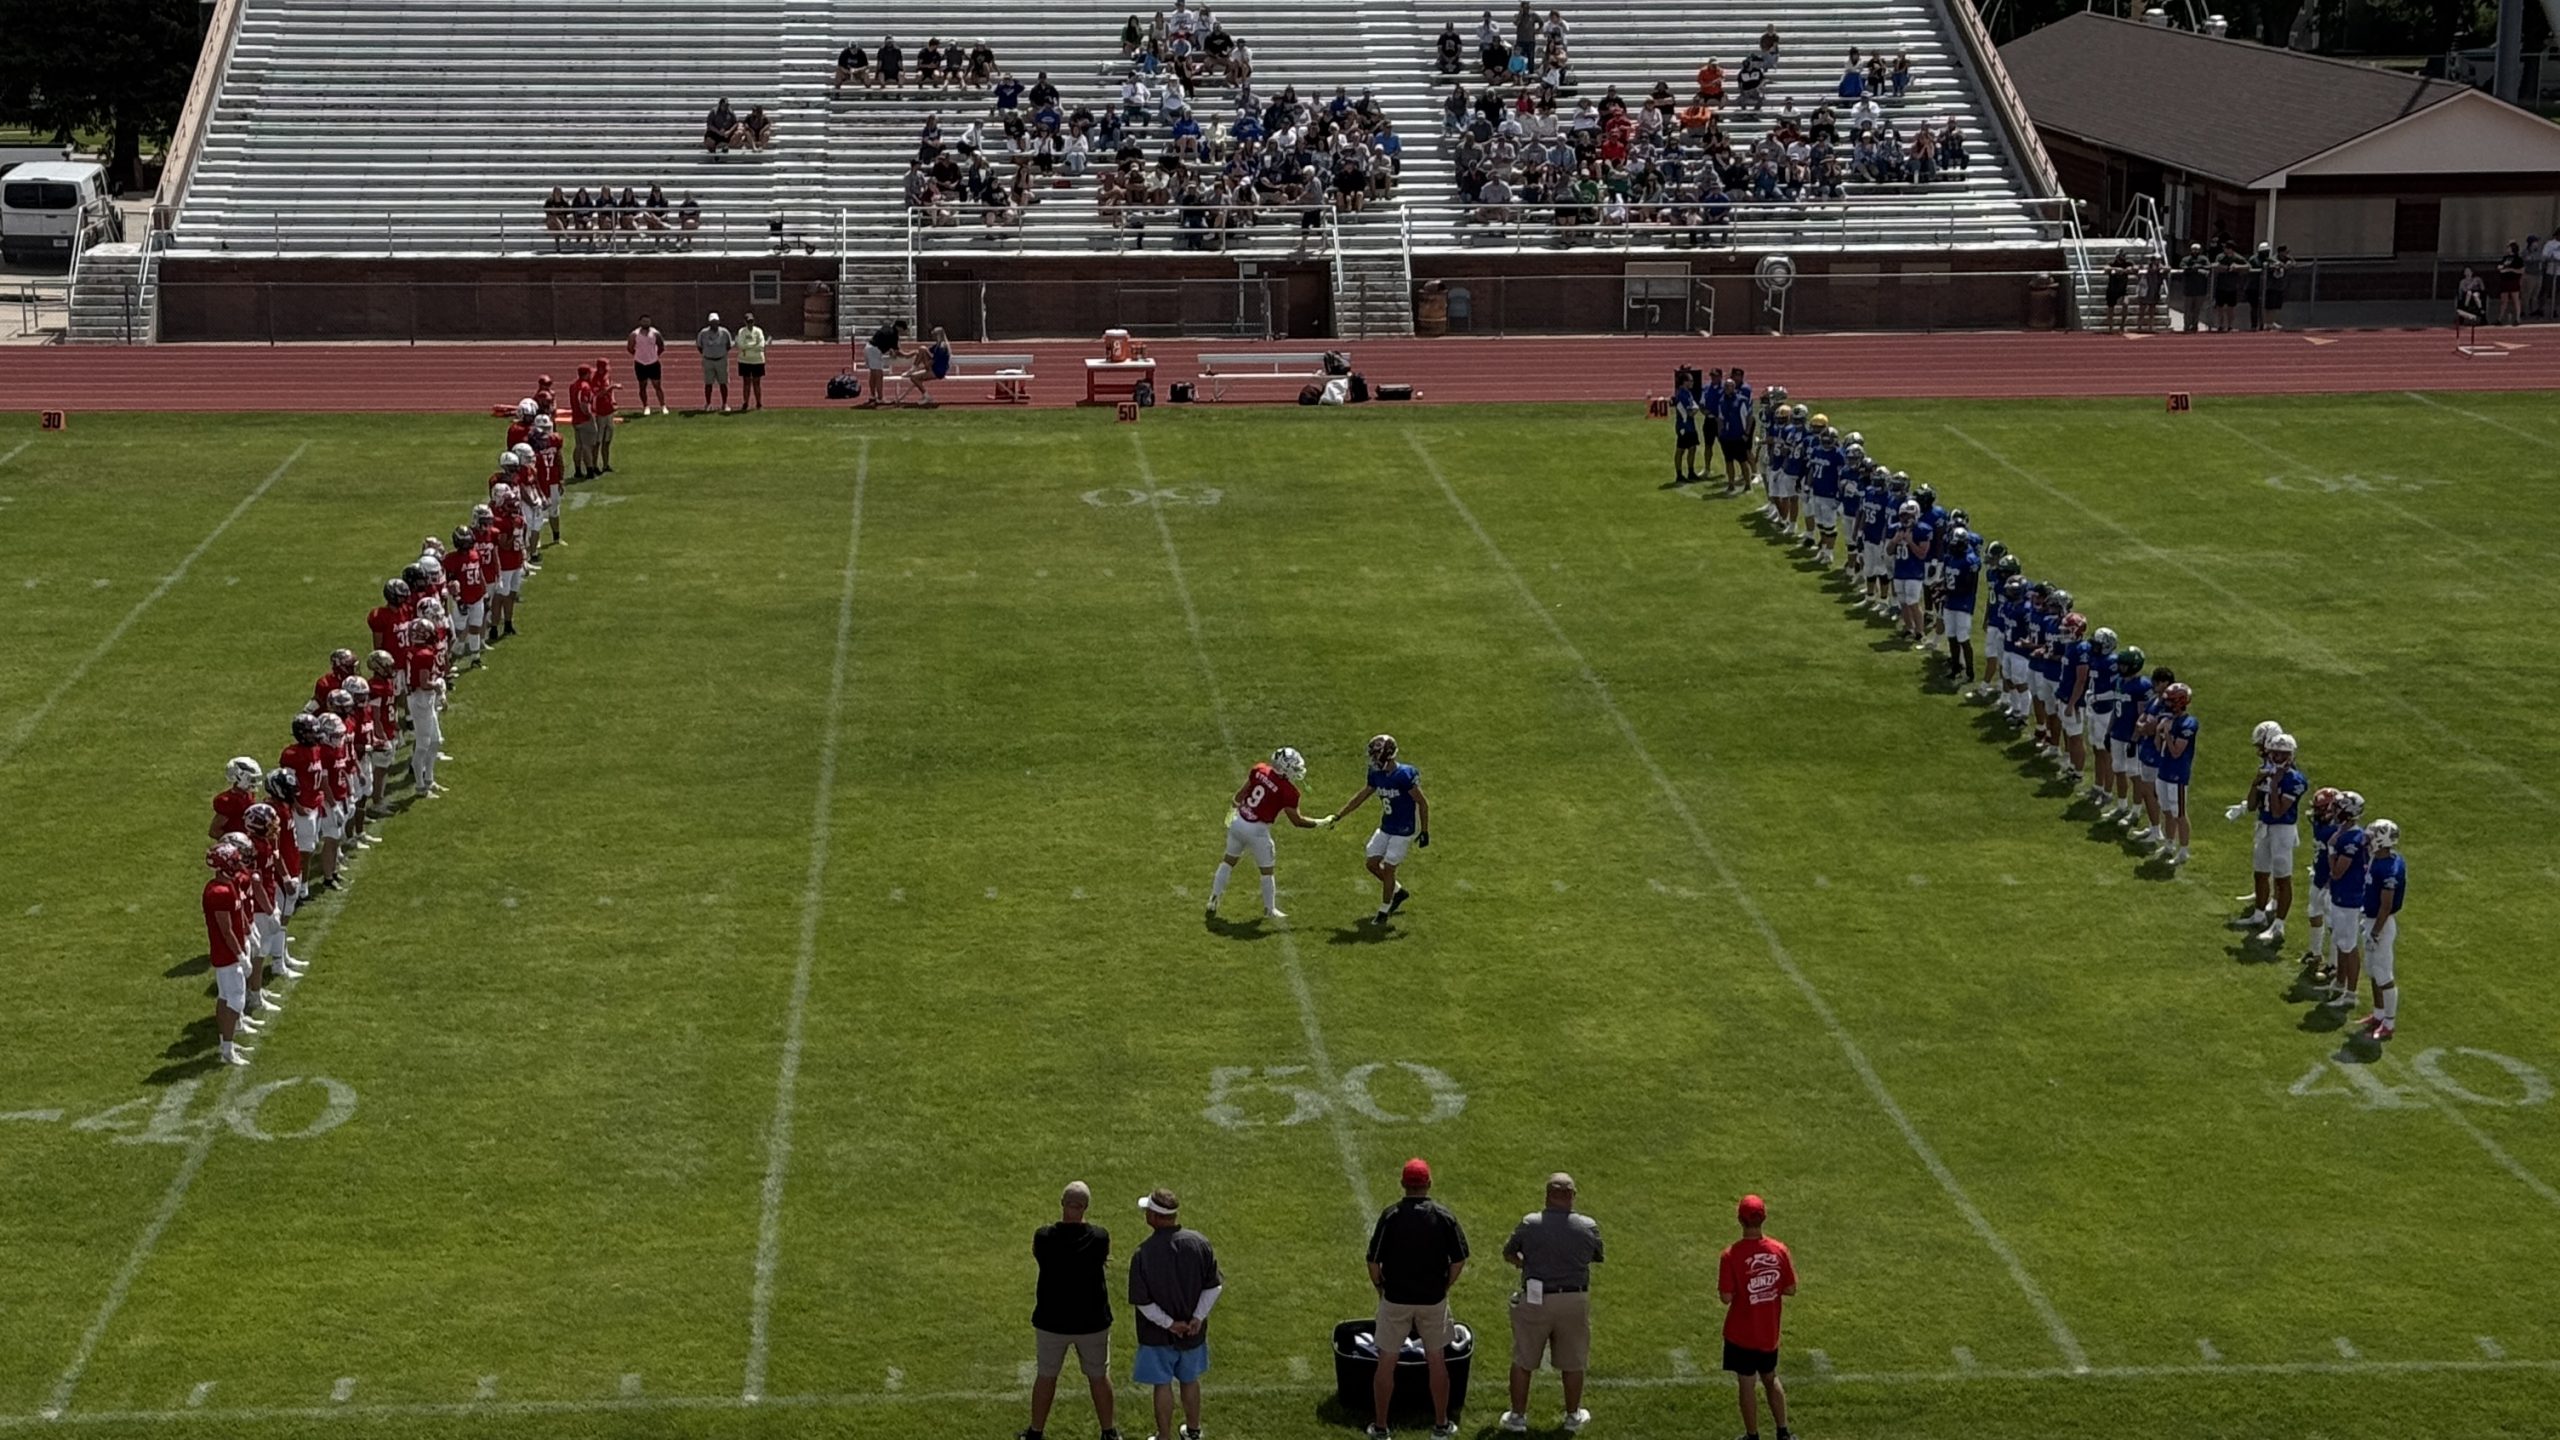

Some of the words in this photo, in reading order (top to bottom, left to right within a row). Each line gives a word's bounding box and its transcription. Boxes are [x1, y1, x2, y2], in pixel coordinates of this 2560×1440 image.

[1650, 400, 1668, 417] 40
[2170, 394, 2189, 411] 30
[43, 412, 62, 429] 30
[1119, 405, 1137, 421] 50
[1246, 784, 1266, 808] 9
[1382, 797, 1393, 816] 6
[2288, 1046, 2554, 1110] 40
[1202, 1060, 1467, 1128] 50
[71, 1076, 358, 1146] 40
